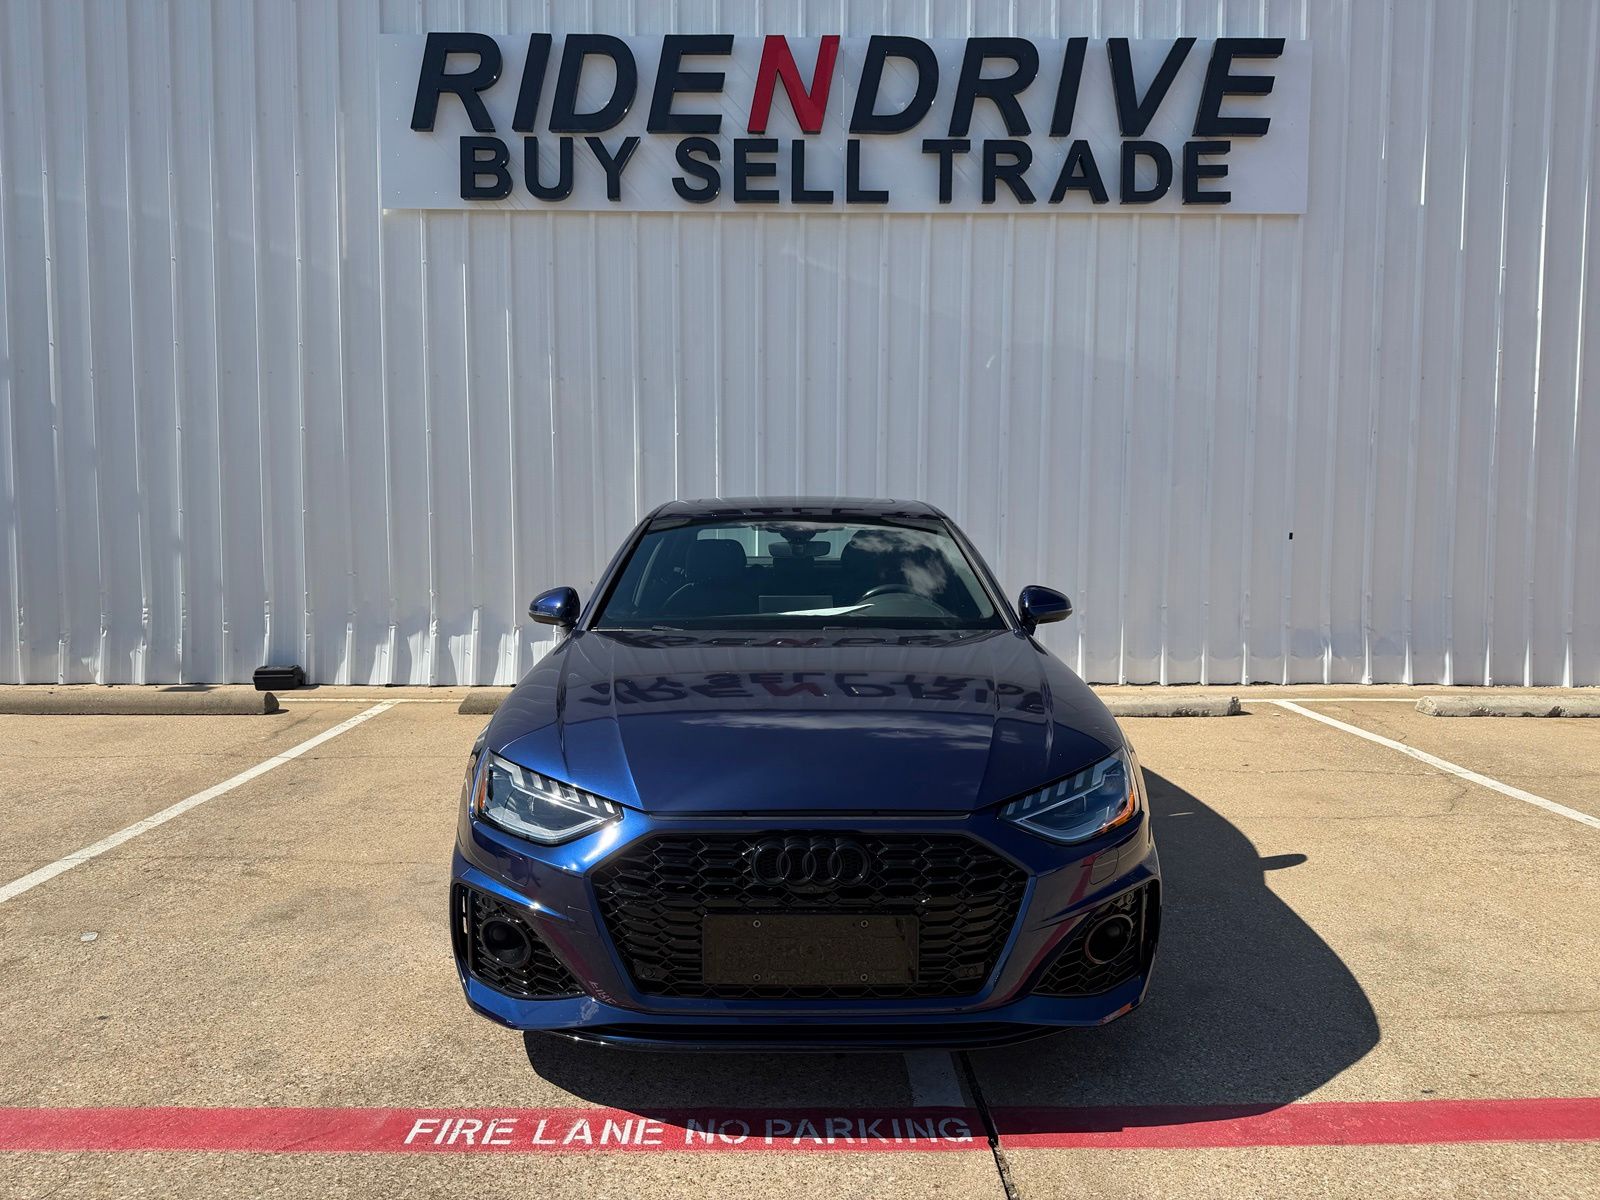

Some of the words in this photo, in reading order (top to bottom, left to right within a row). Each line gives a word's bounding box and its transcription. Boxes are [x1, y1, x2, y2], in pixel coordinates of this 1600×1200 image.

[460, 136, 641, 202] BUY
[672, 137, 890, 204] SELL
[922, 139, 1232, 205] TRADE
[404, 1118, 518, 1145] FIRE
[532, 1118, 666, 1145] LANE
[684, 1118, 751, 1145] NO
[763, 1117, 974, 1144] PARKING
